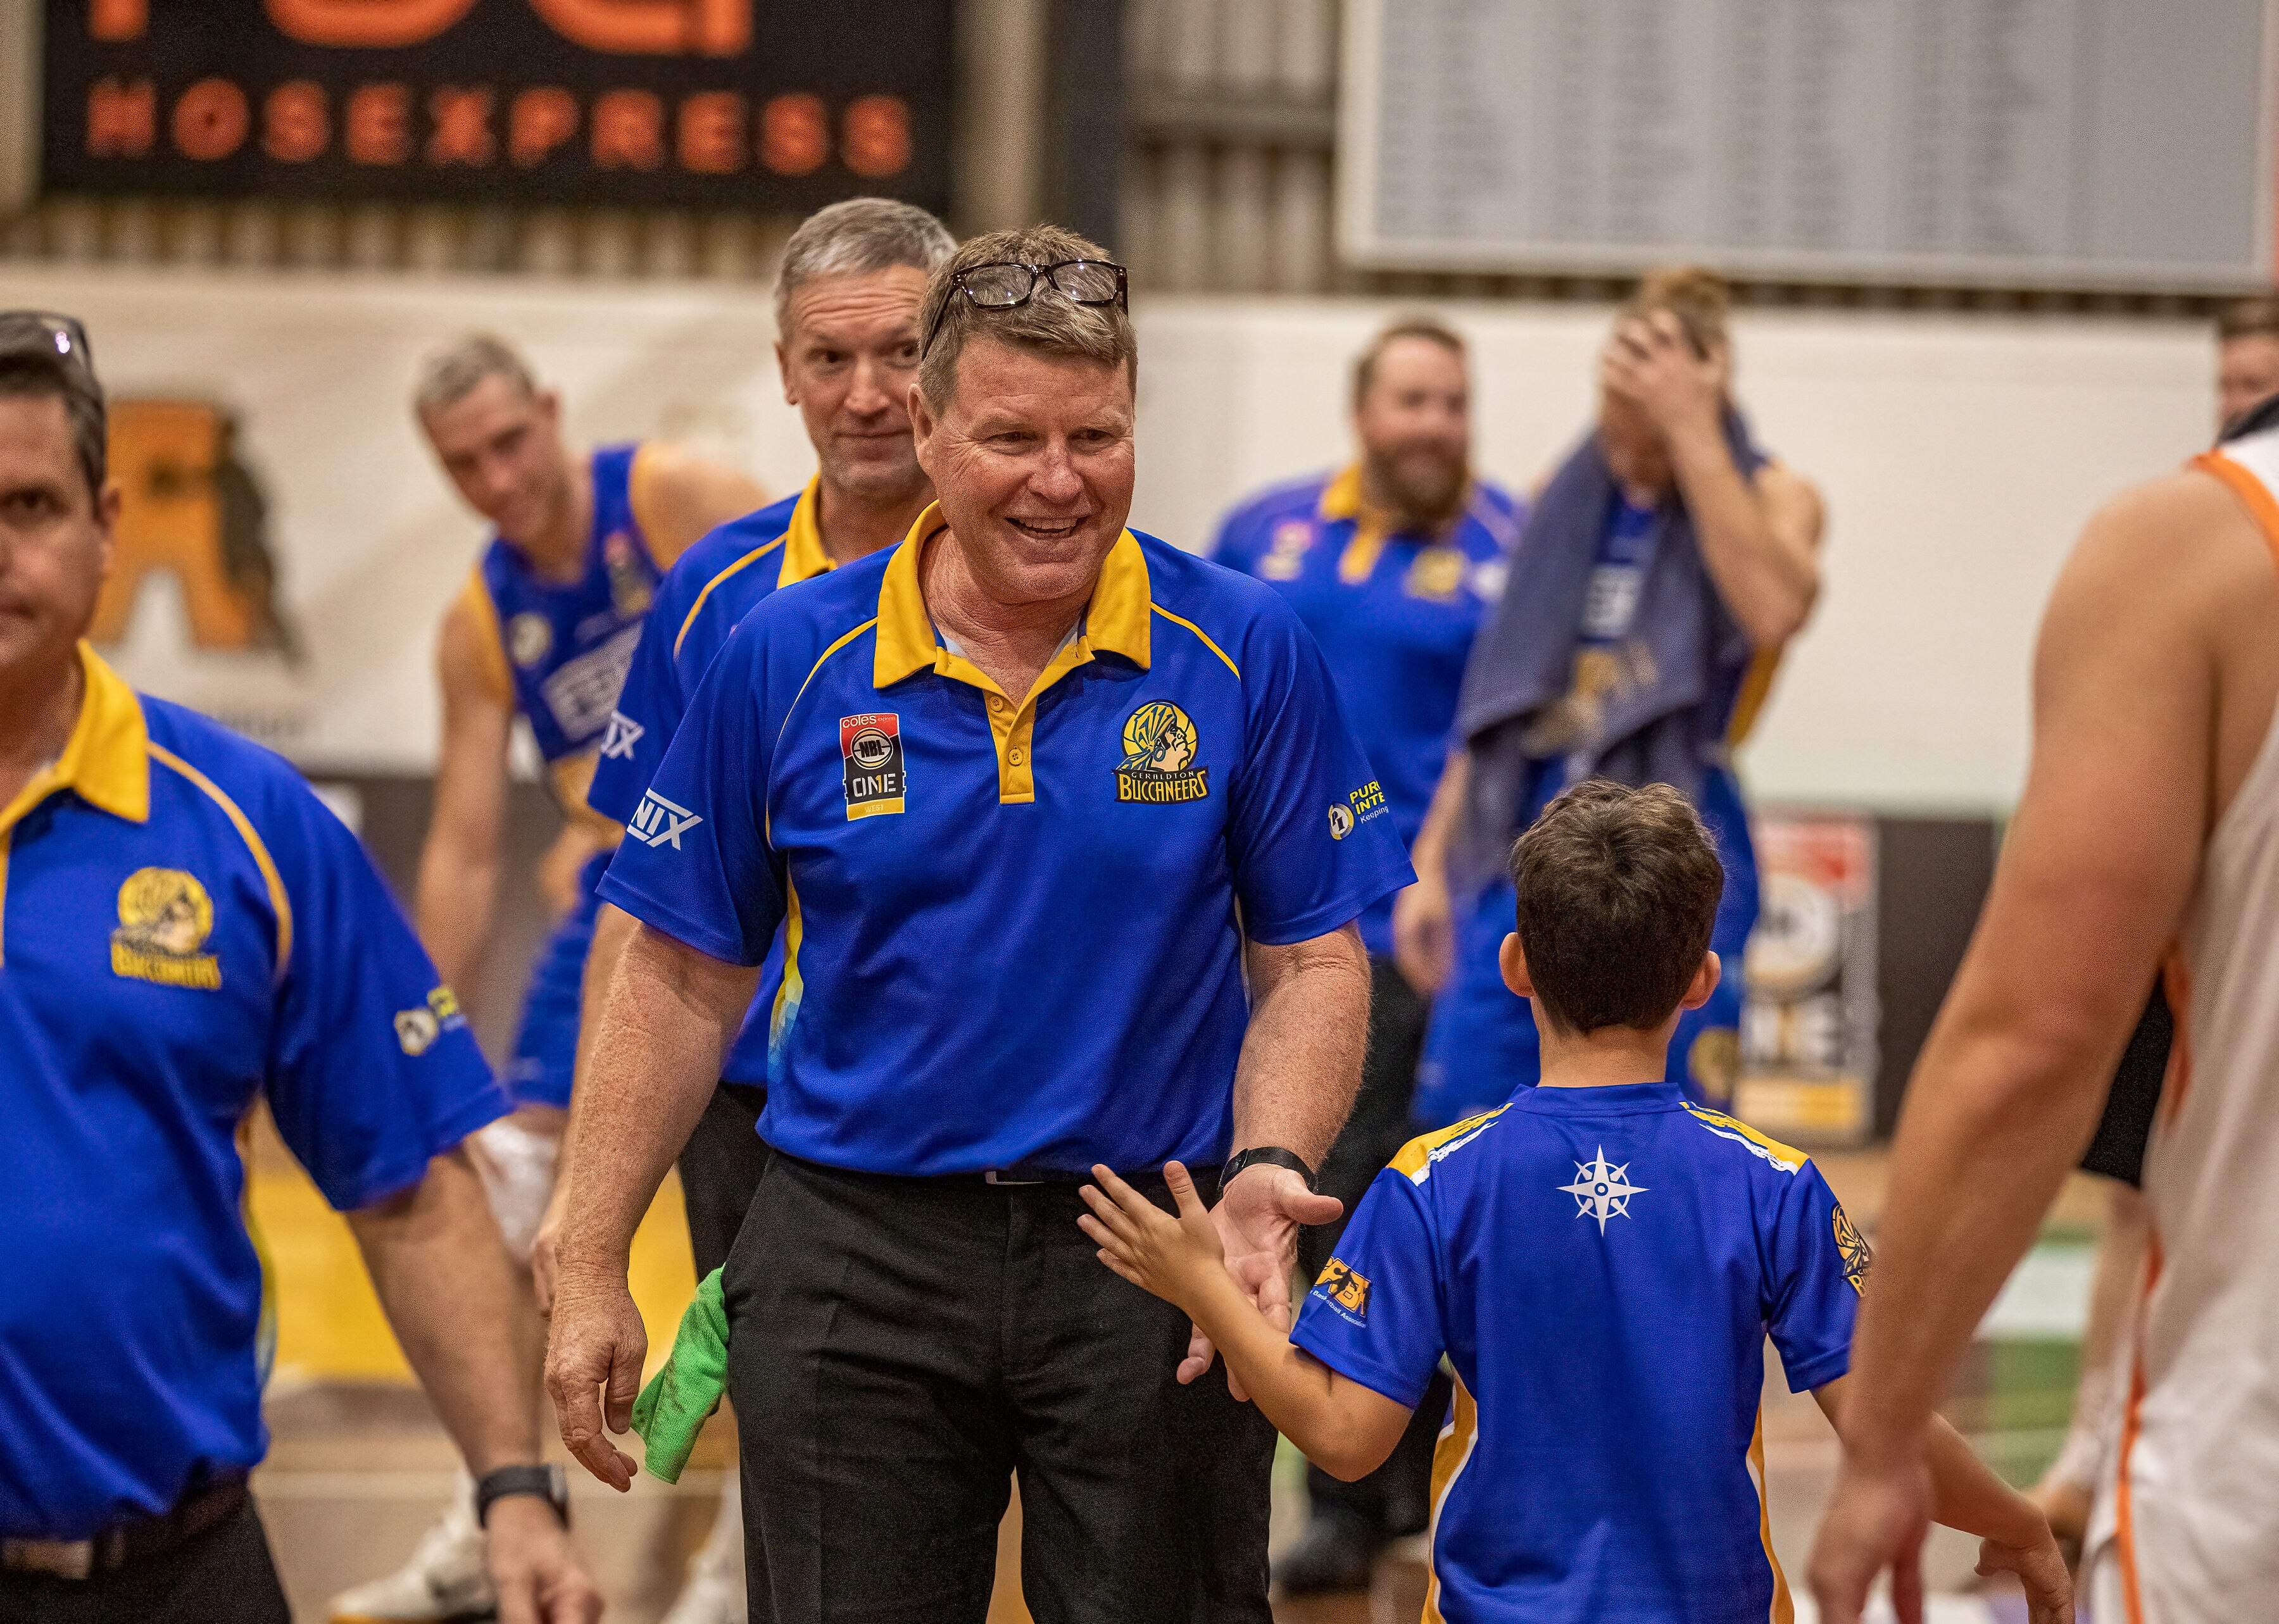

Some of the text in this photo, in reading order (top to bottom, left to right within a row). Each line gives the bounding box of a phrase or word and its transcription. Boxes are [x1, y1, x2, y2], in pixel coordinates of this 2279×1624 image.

[85, 77, 913, 177] HOSEXPRESS
[842, 715, 877, 728] coles
[858, 739, 885, 758] NBL
[1119, 770, 1207, 802] BUCCANEERS
[1131, 770, 1194, 780] GERALDTON
[631, 795, 703, 851] NIX
